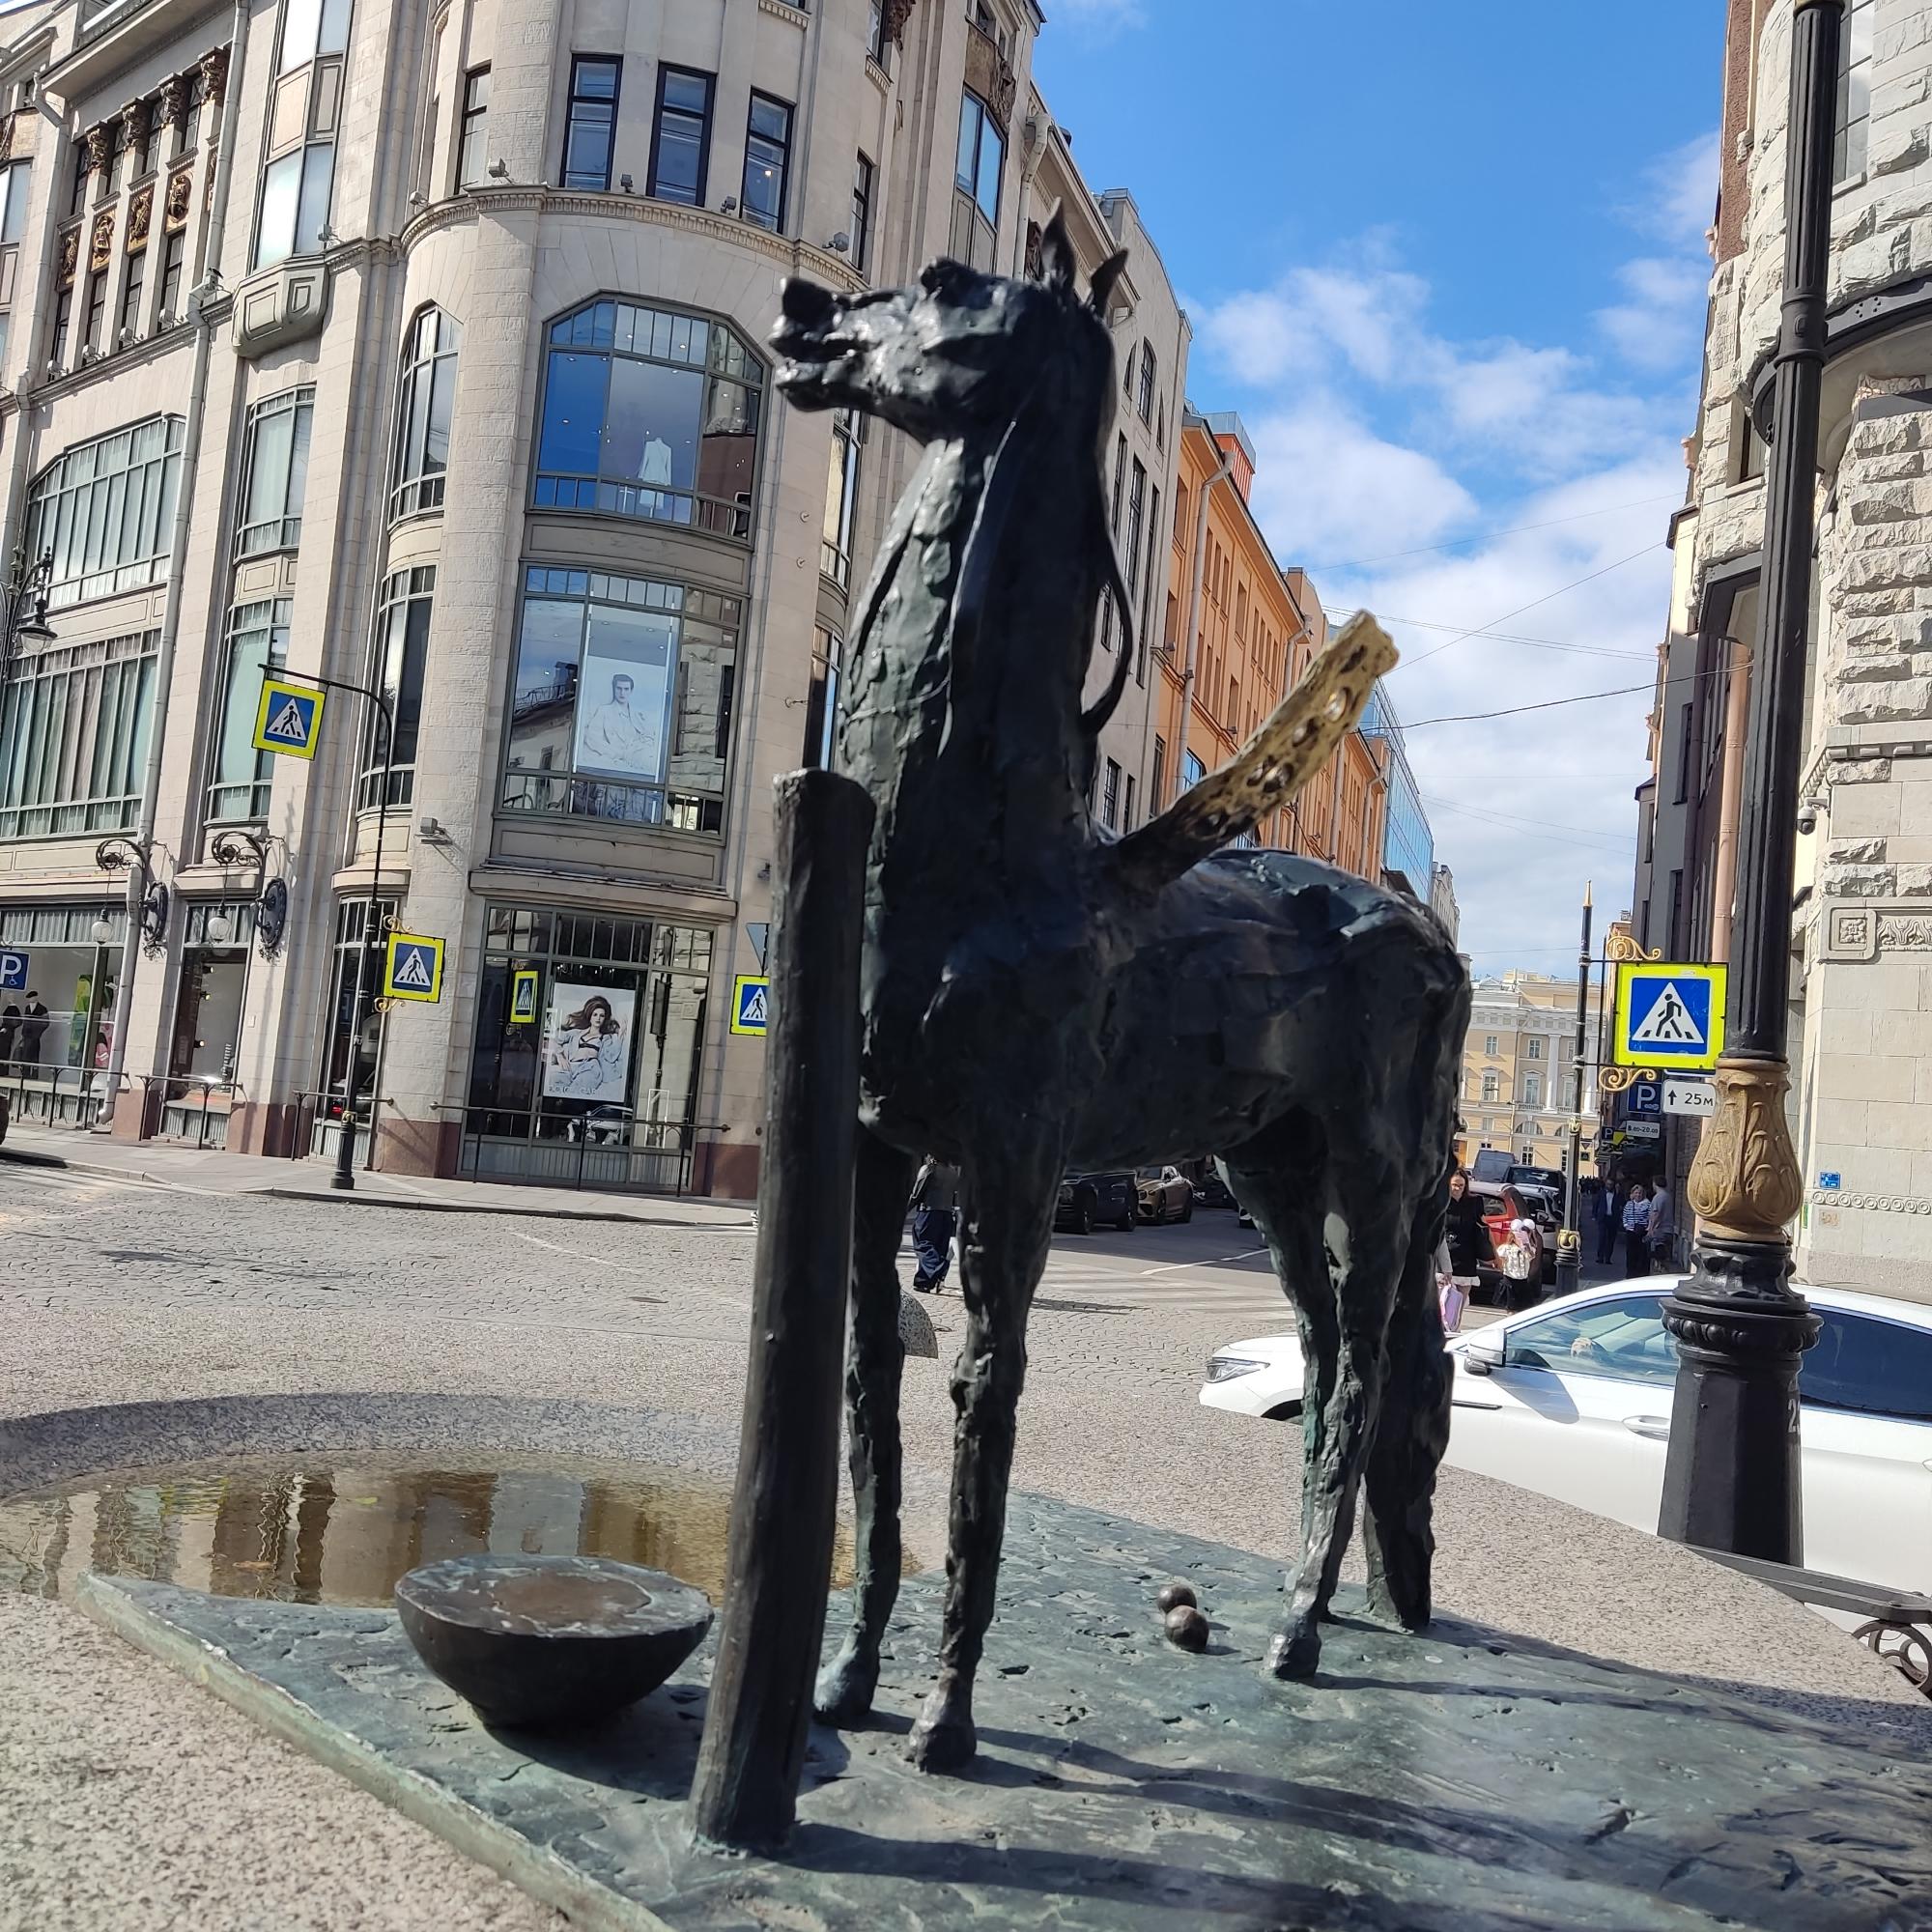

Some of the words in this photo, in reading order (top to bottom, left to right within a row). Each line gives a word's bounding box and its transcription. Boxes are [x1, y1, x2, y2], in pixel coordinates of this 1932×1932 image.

[0, 954, 22, 984] P
[1636, 1085, 1656, 1110] P
[1605, 1127, 1613, 1139] P
